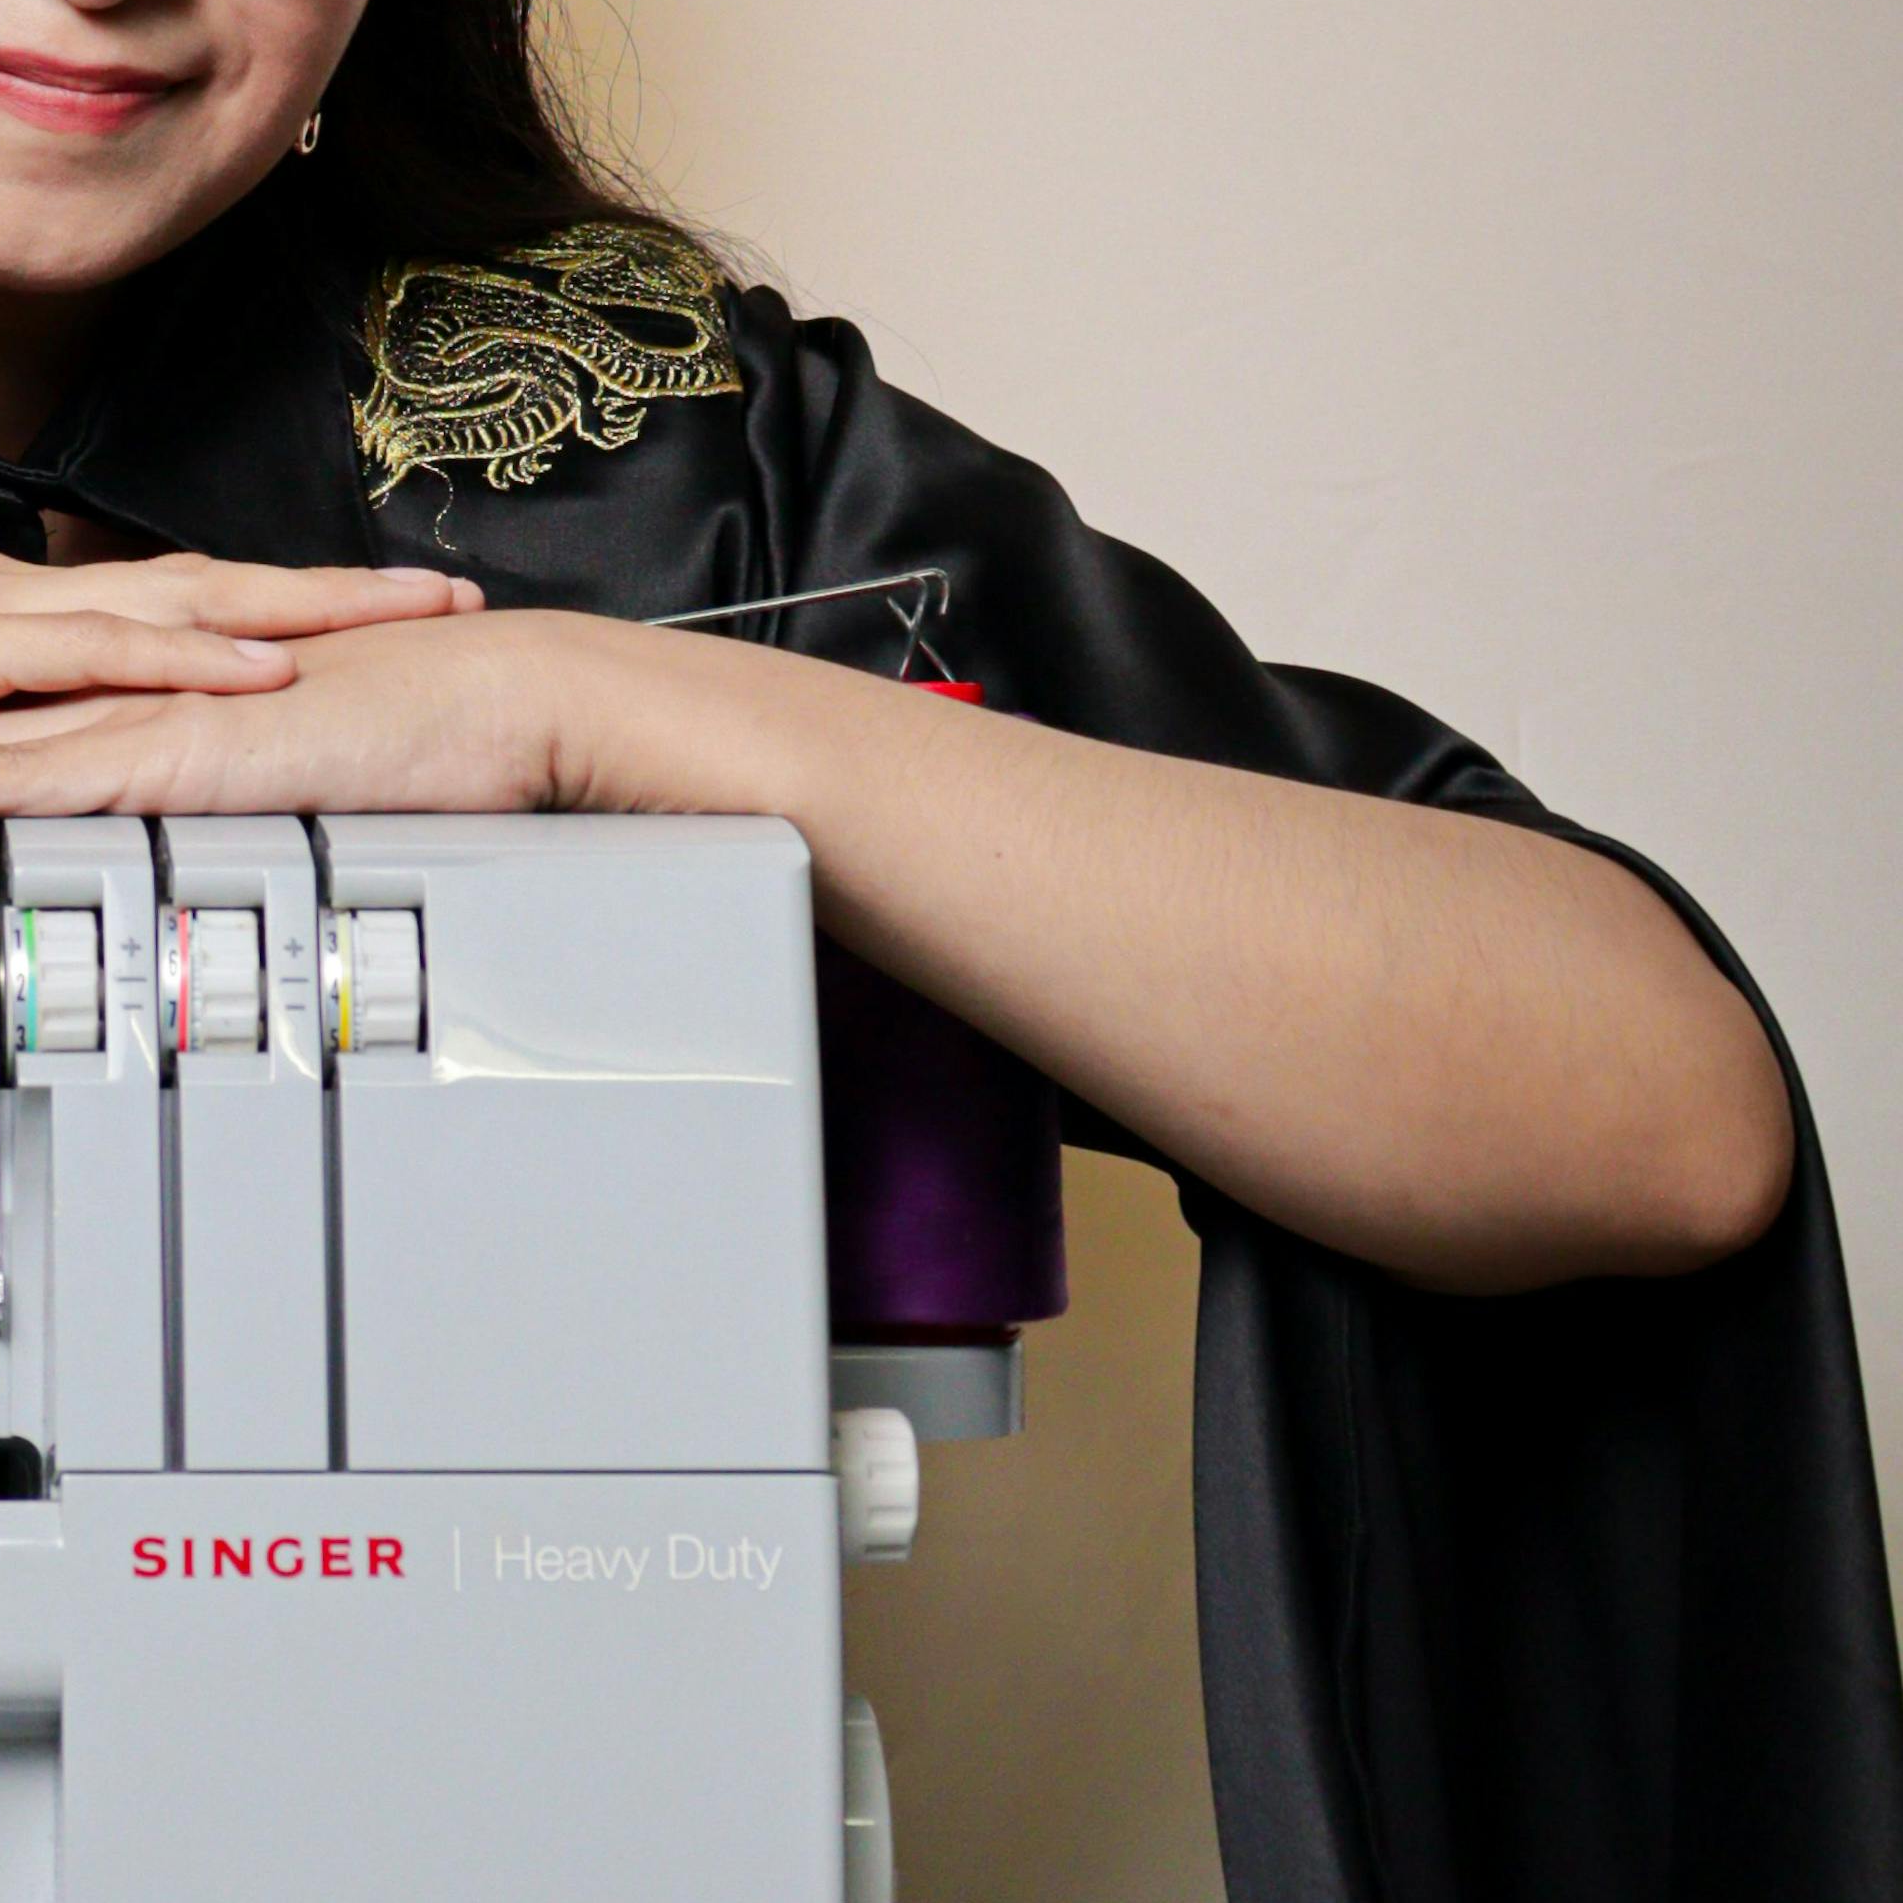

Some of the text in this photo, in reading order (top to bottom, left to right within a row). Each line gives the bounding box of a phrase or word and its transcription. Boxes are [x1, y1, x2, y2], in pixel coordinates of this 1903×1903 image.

[327, 931, 338, 953] 3
[168, 950, 178, 976] 6
[15, 974, 26, 1002] 2
[168, 1000, 178, 1028] 7
[16, 1025, 27, 1051] 3
[131, 1533, 784, 1591] SINGER Heavy Duty
